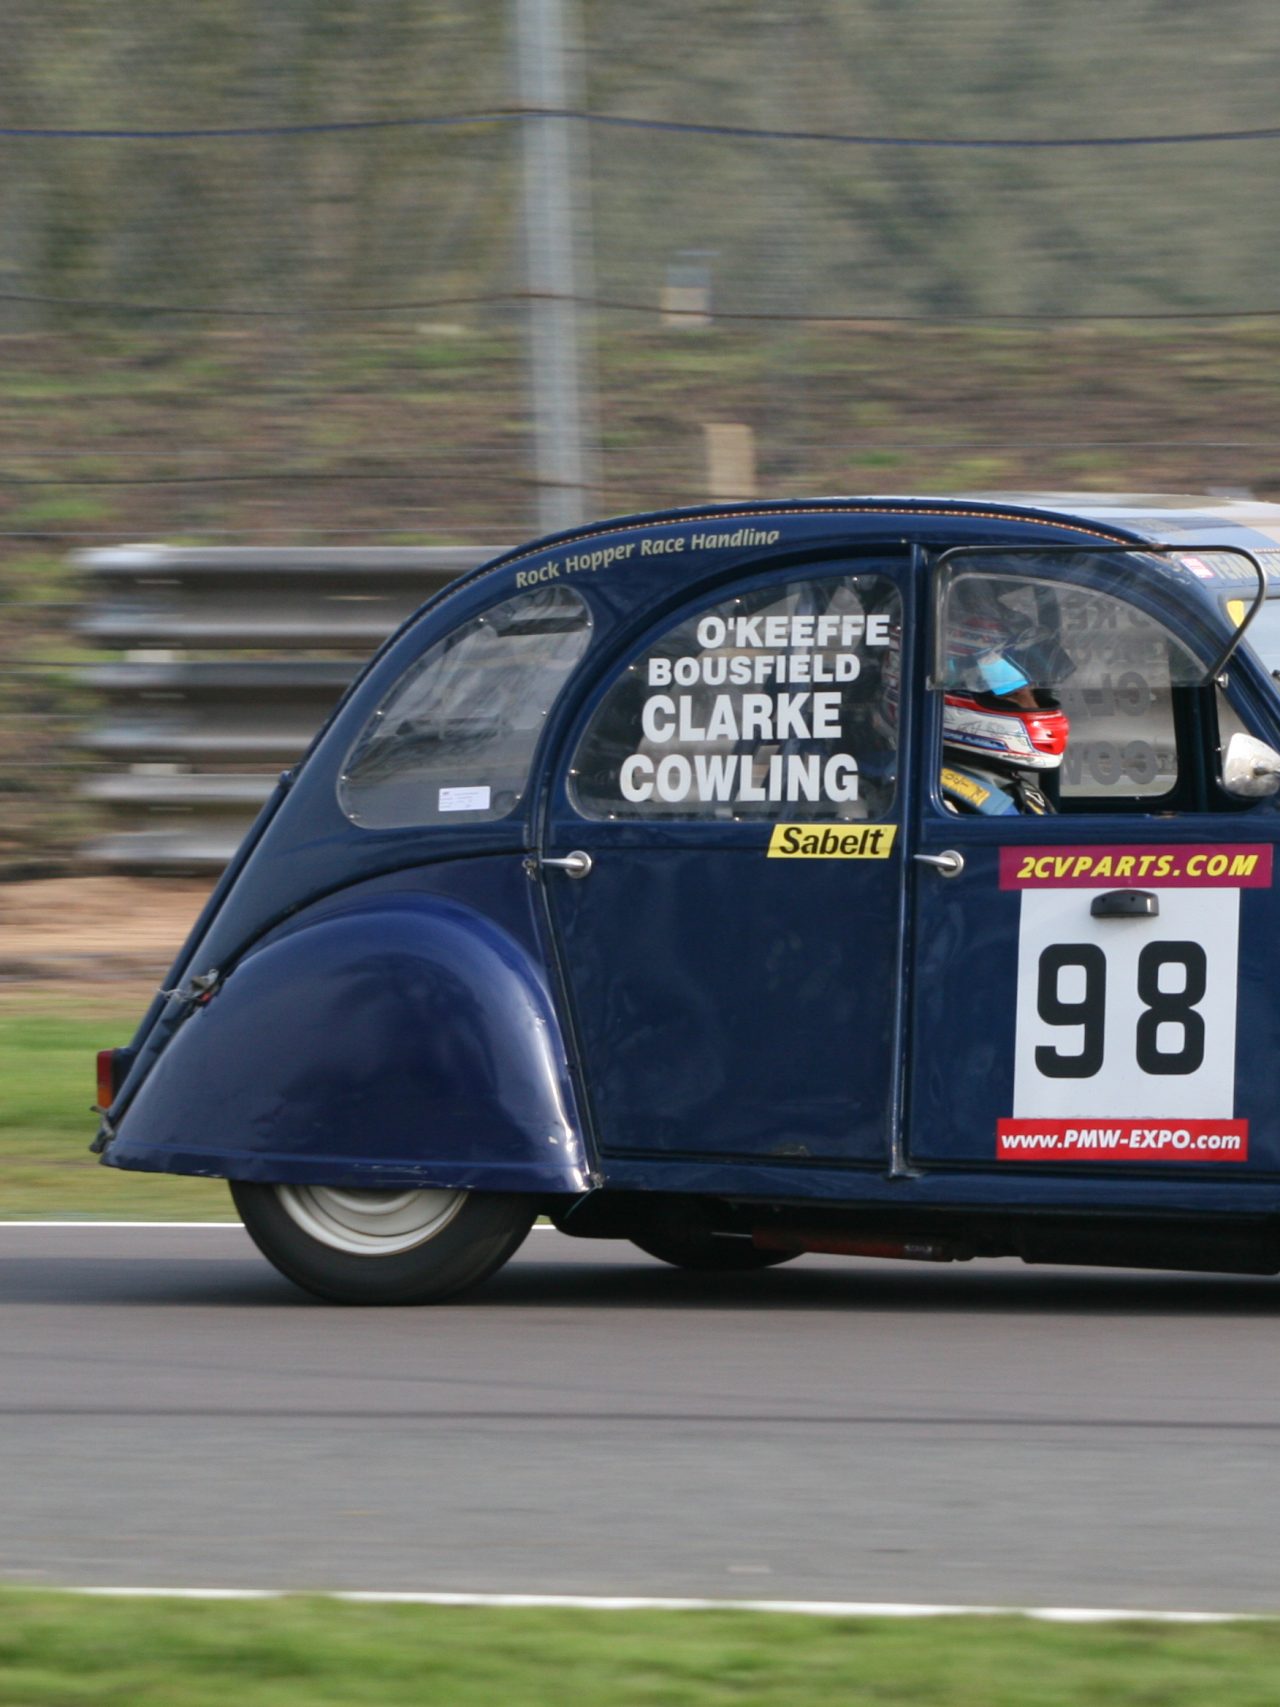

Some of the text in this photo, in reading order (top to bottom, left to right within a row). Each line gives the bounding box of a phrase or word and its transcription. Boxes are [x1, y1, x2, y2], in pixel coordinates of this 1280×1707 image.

[516, 561, 559, 588] Rock
[565, 541, 636, 572] Hopper
[640, 536, 684, 556] Race
[697, 614, 890, 649] O'KEEFFE
[648, 653, 861, 686] BOUSFIELD
[642, 691, 842, 743] CLARKE
[619, 753, 859, 802] COWLING
[779, 827, 884, 855] Sabelt
[1016, 854, 1259, 878] 2CVPARTS.COM
[1035, 940, 1207, 1078] 98
[1001, 1129, 1241, 1150] www.PMW-EXPO.com
